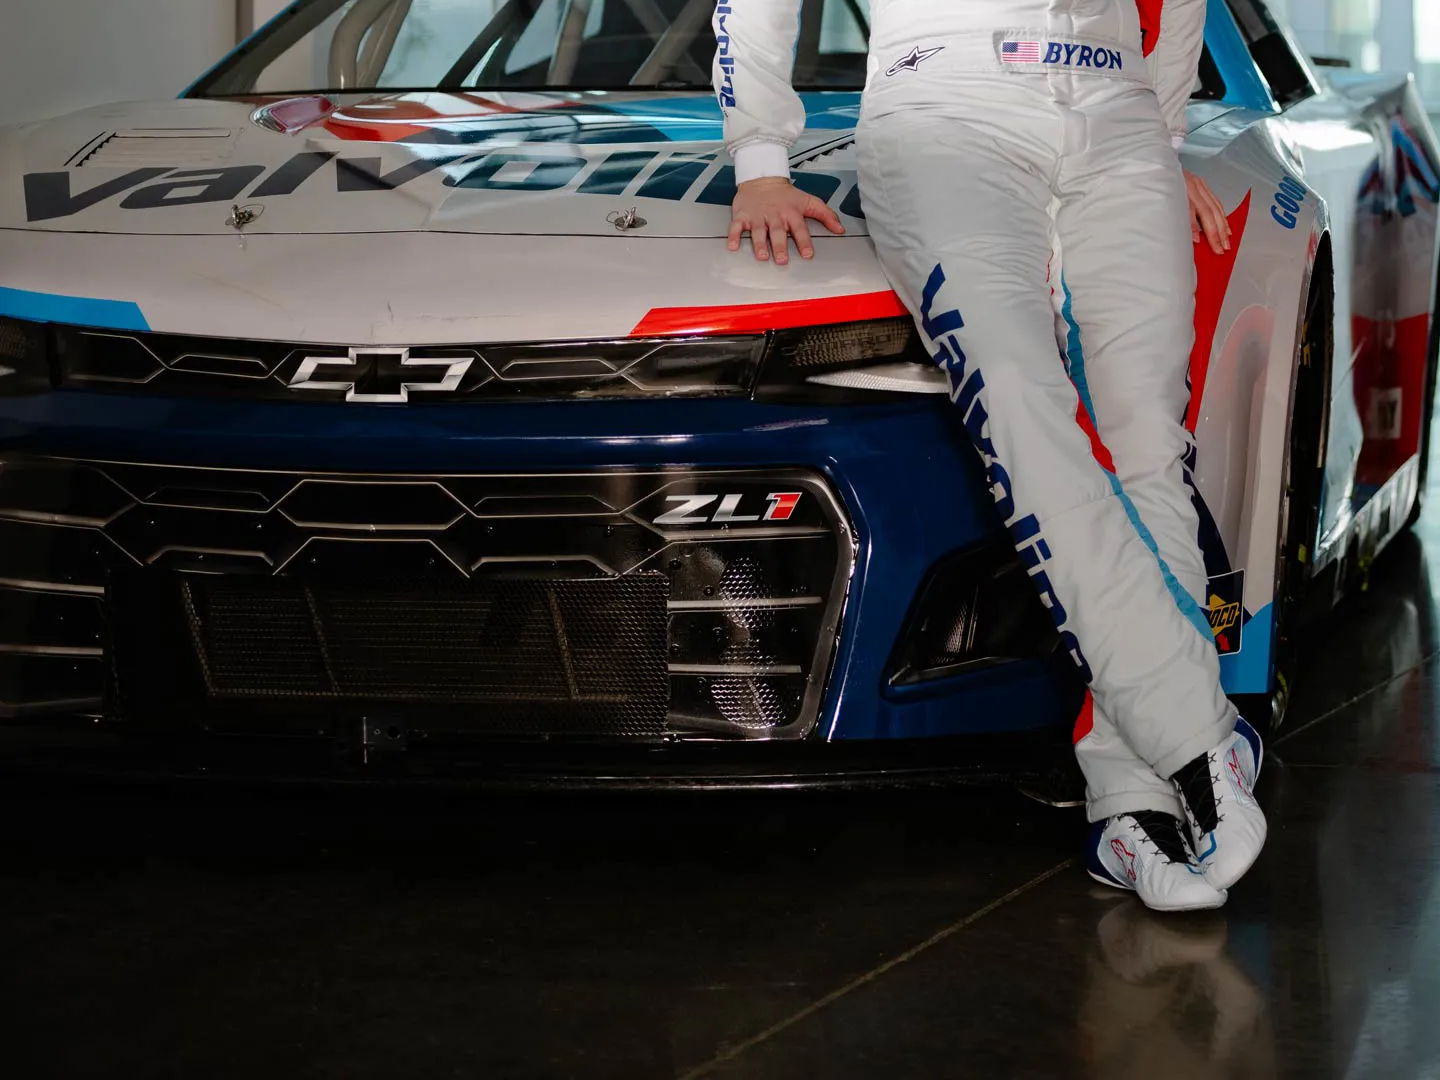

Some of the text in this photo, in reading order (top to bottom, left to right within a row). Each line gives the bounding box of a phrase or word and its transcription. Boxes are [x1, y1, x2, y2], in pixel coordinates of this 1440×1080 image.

[1042, 41, 1123, 71] BYRON
[24, 149, 866, 223] Valvolin
[652, 491, 804, 525] ZL1
[1209, 603, 1239, 628] OCO
